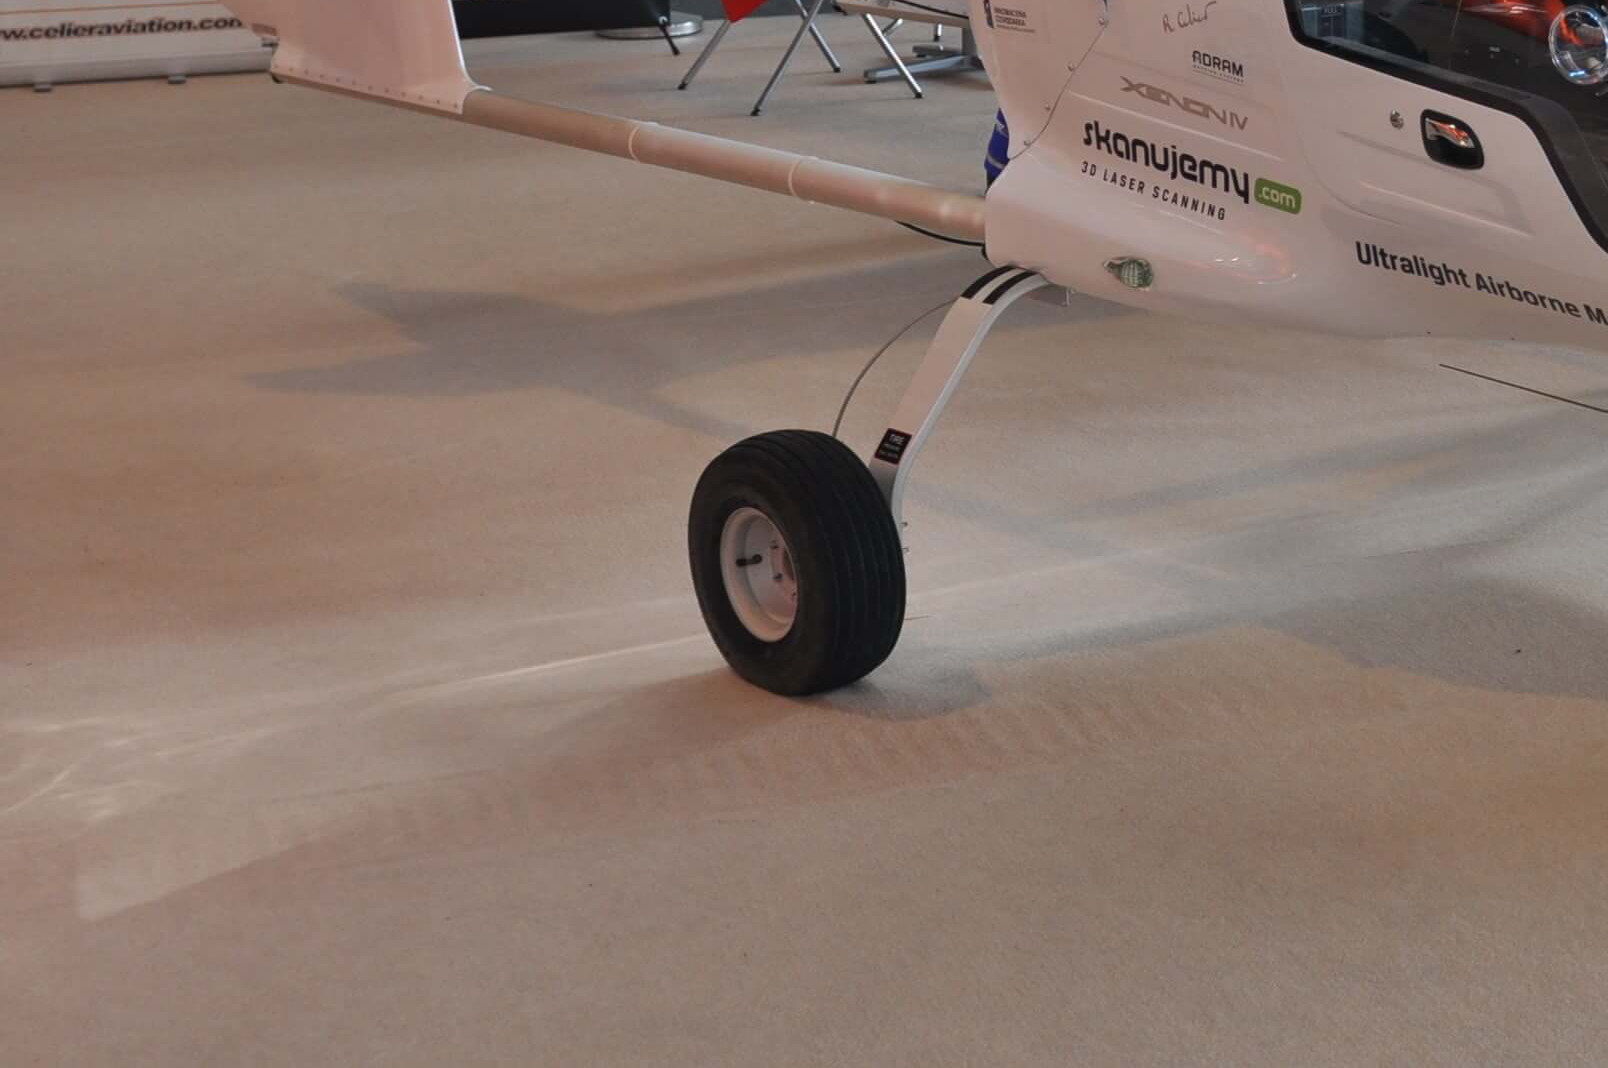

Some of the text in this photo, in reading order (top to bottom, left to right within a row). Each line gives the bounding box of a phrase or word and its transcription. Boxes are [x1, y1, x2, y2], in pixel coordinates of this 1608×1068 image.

[1080, 160, 1227, 222] 3D LASER SCANNING
[1354, 241, 1471, 292] Ultralight
[1474, 273, 1582, 321] Airborne
